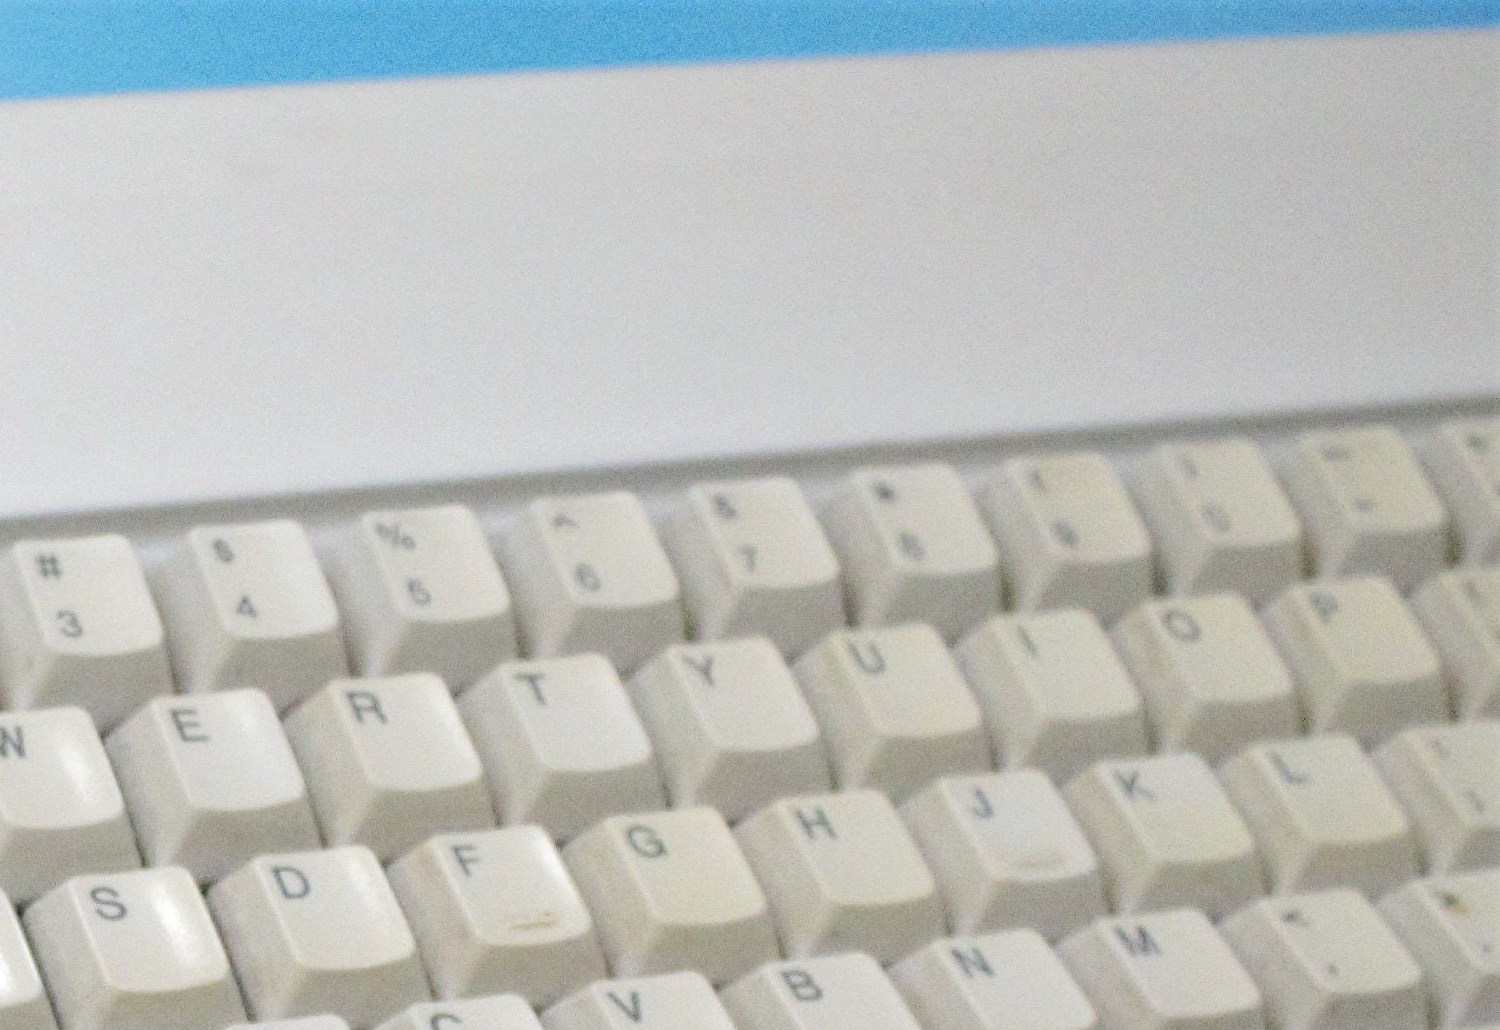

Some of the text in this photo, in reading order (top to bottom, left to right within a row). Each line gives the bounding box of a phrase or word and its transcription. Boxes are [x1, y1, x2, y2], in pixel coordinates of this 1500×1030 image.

[36, 553, 61, 579] #
[235, 595, 258, 619] 4
[407, 579, 431, 606] 5
[57, 610, 83, 638] 3
[1163, 608, 1200, 642] O
[682, 655, 714, 686] Y
[848, 641, 885, 675] U
[515, 672, 547, 705] T
[346, 691, 388, 725] R
[169, 708, 208, 743] E
[1268, 753, 1306, 784] L
[1114, 770, 1155, 800] K
[971, 787, 994, 818] J
[795, 808, 837, 841] H
[625, 824, 668, 859] G
[452, 844, 478, 876] F
[273, 865, 310, 900] D
[90, 887, 127, 921] S
[1115, 925, 1161, 956] M
[951, 947, 994, 979] N
[782, 970, 823, 1001] B
[608, 991, 642, 1023] V
